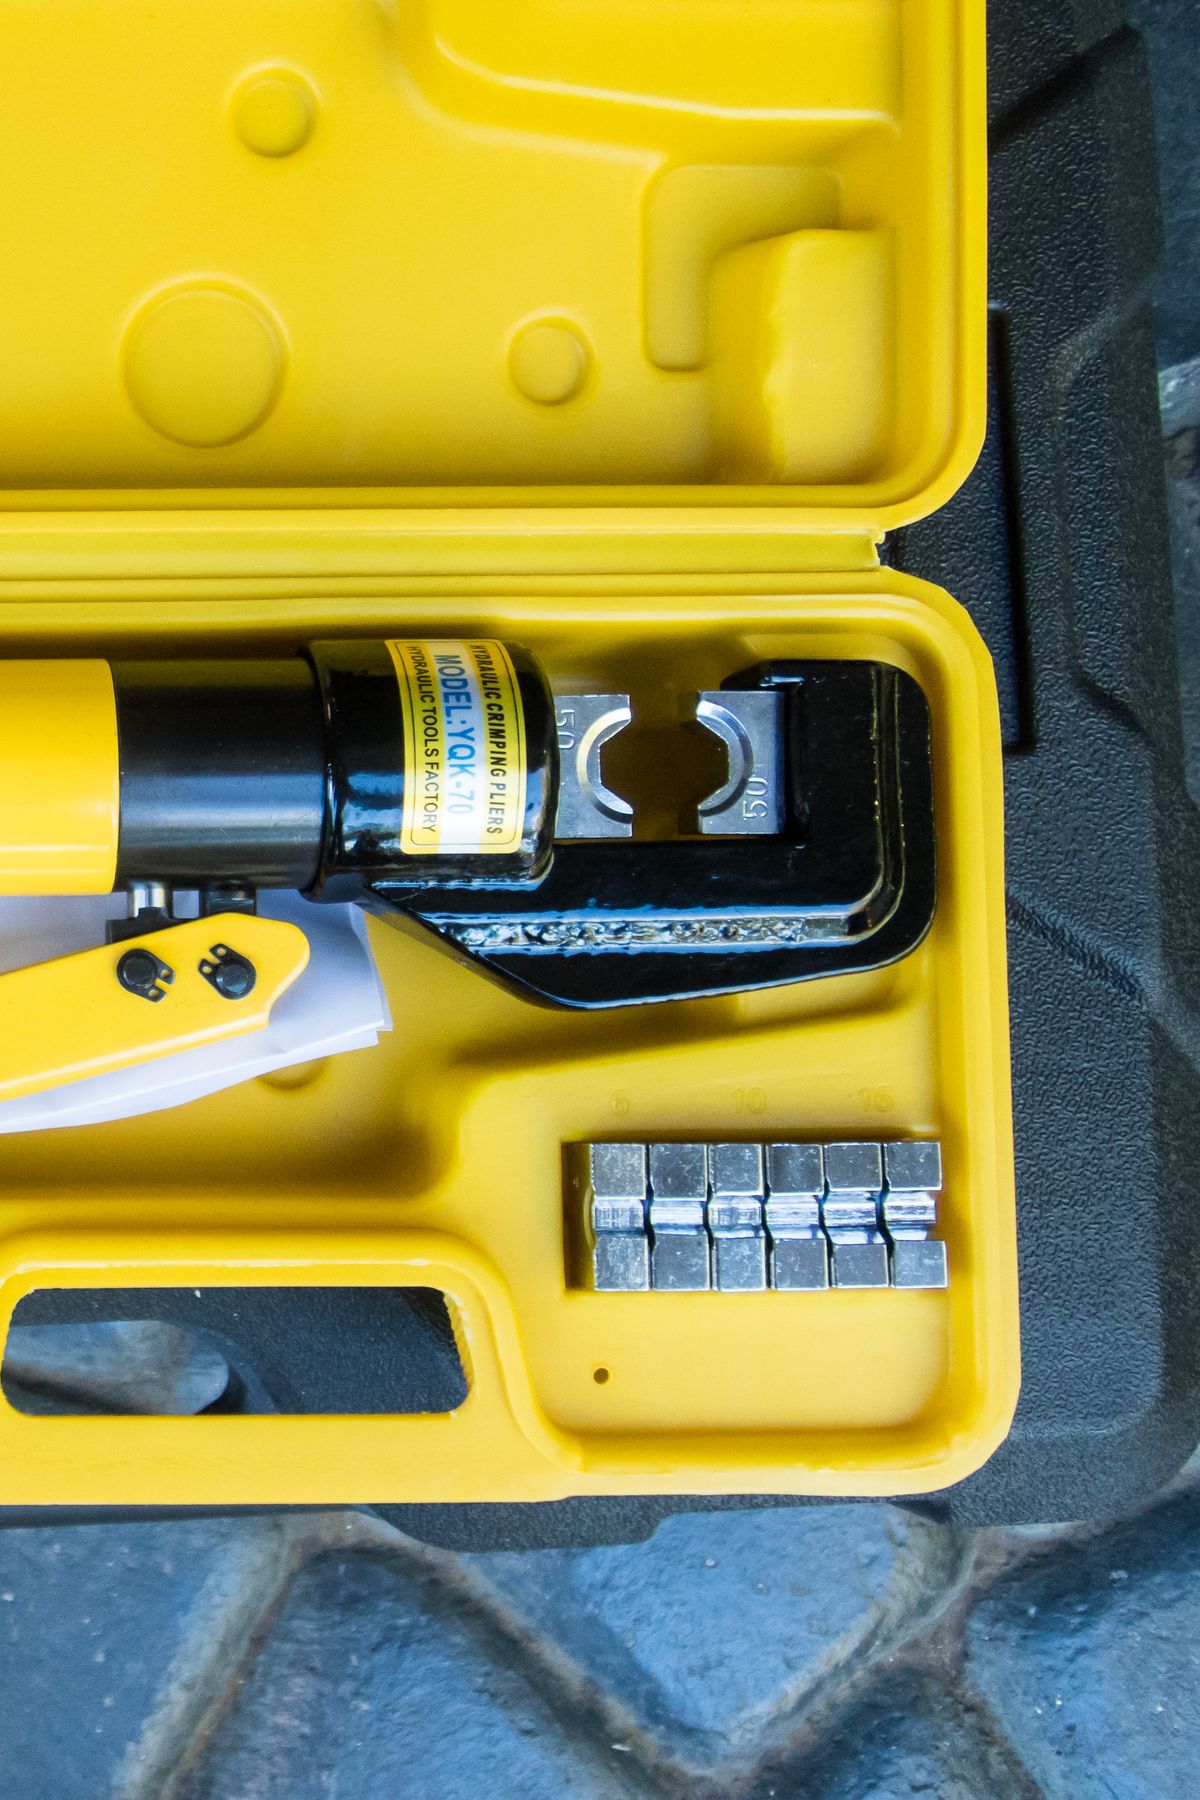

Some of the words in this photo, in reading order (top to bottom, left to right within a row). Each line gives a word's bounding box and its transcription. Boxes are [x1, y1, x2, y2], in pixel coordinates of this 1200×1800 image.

[406, 645, 435, 704] HYDRAULIC
[470, 645, 502, 699] HYDRAULIC
[422, 707, 439, 757] TOOLS
[487, 704, 507, 777] CRIMPING
[422, 762, 439, 833] FACTORY
[486, 782, 507, 834] PLIERS
[743, 777, 768, 820] 50
